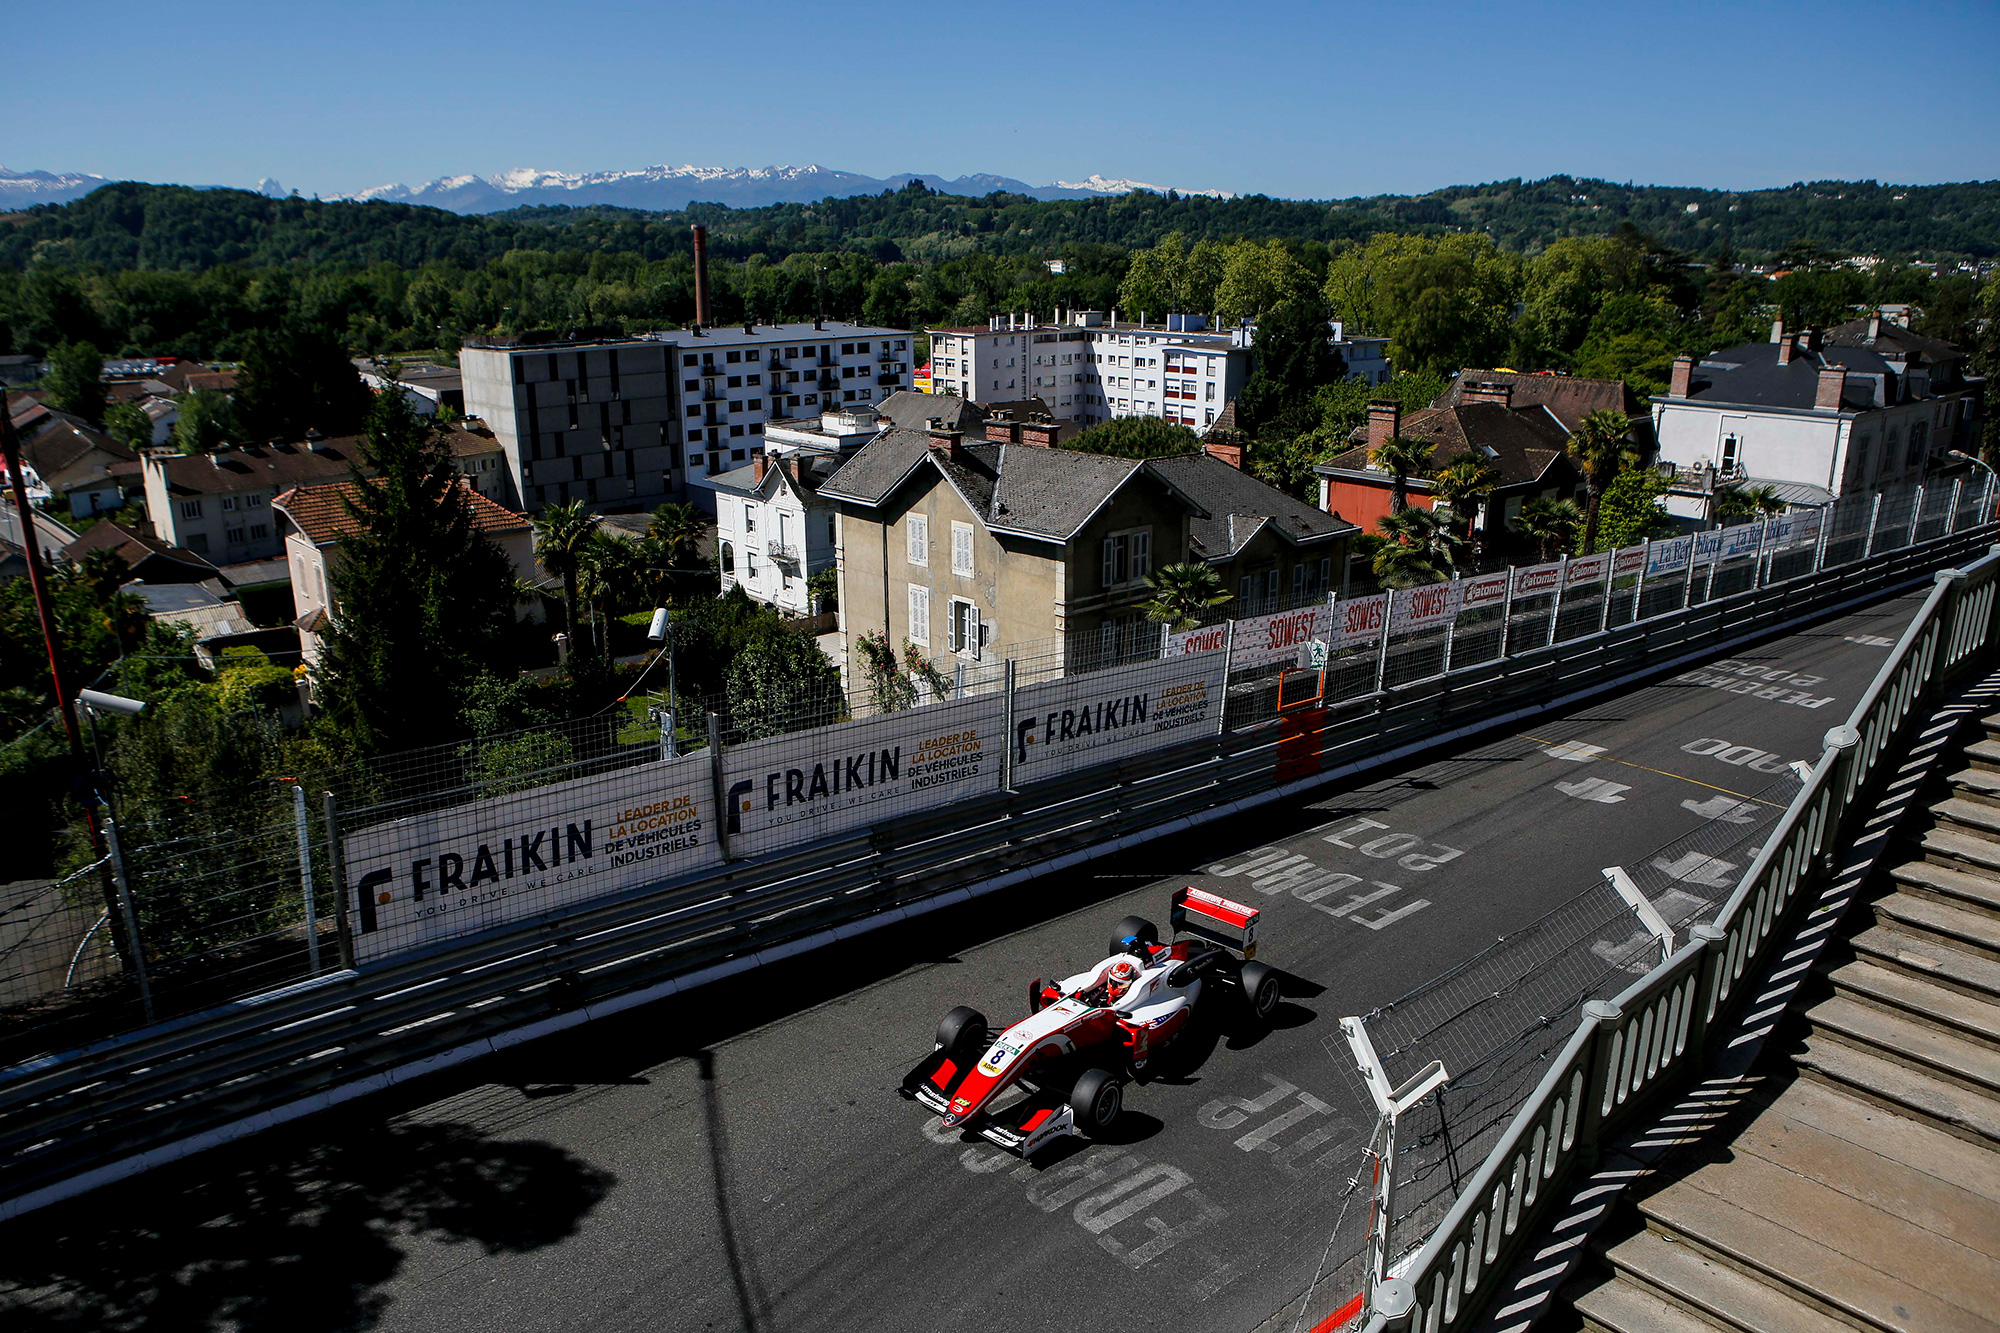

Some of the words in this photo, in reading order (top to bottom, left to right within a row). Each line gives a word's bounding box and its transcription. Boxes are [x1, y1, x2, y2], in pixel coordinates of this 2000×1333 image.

[1410, 587, 1449, 620] SOWEST
[1345, 600, 1385, 633] SOWES
[1268, 612, 1316, 650] SOWEST
[1156, 700, 1166, 710] LA
[1168, 690, 1206, 707] LOCATION
[1162, 684, 1191, 698] LEADER
[1194, 680, 1205, 690] DE
[1045, 693, 1148, 745] FRAIKIN
[919, 733, 959, 750] LEADER
[962, 730, 977, 741] DE
[912, 754, 925, 765] LA
[928, 741, 981, 762] LOCATION
[767, 746, 900, 811] FRAIKIN
[908, 766, 922, 778] DE
[911, 765, 979, 790] INDUSTRIELS
[616, 798, 671, 823] LEADER
[673, 794, 691, 810] DE
[769, 814, 792, 825] YOU
[848, 795, 863, 805] WE
[871, 786, 900, 799] CARE
[609, 826, 627, 840] LA
[629, 806, 698, 837] LOCATION
[412, 819, 593, 902] FRAIKIN
[605, 841, 624, 856] DE
[610, 834, 699, 868] INDUSTRIELS
[415, 903, 448, 918] YOU
[526, 877, 547, 891] WE
[556, 865, 595, 883] CARE
[1249, 927, 1254, 943] 8
[990, 1050, 1005, 1064] 8
[997, 1041, 1017, 1055] DEKRA
[984, 1063, 998, 1072] ADAC
[918, 1083, 950, 1106] Armstrong
